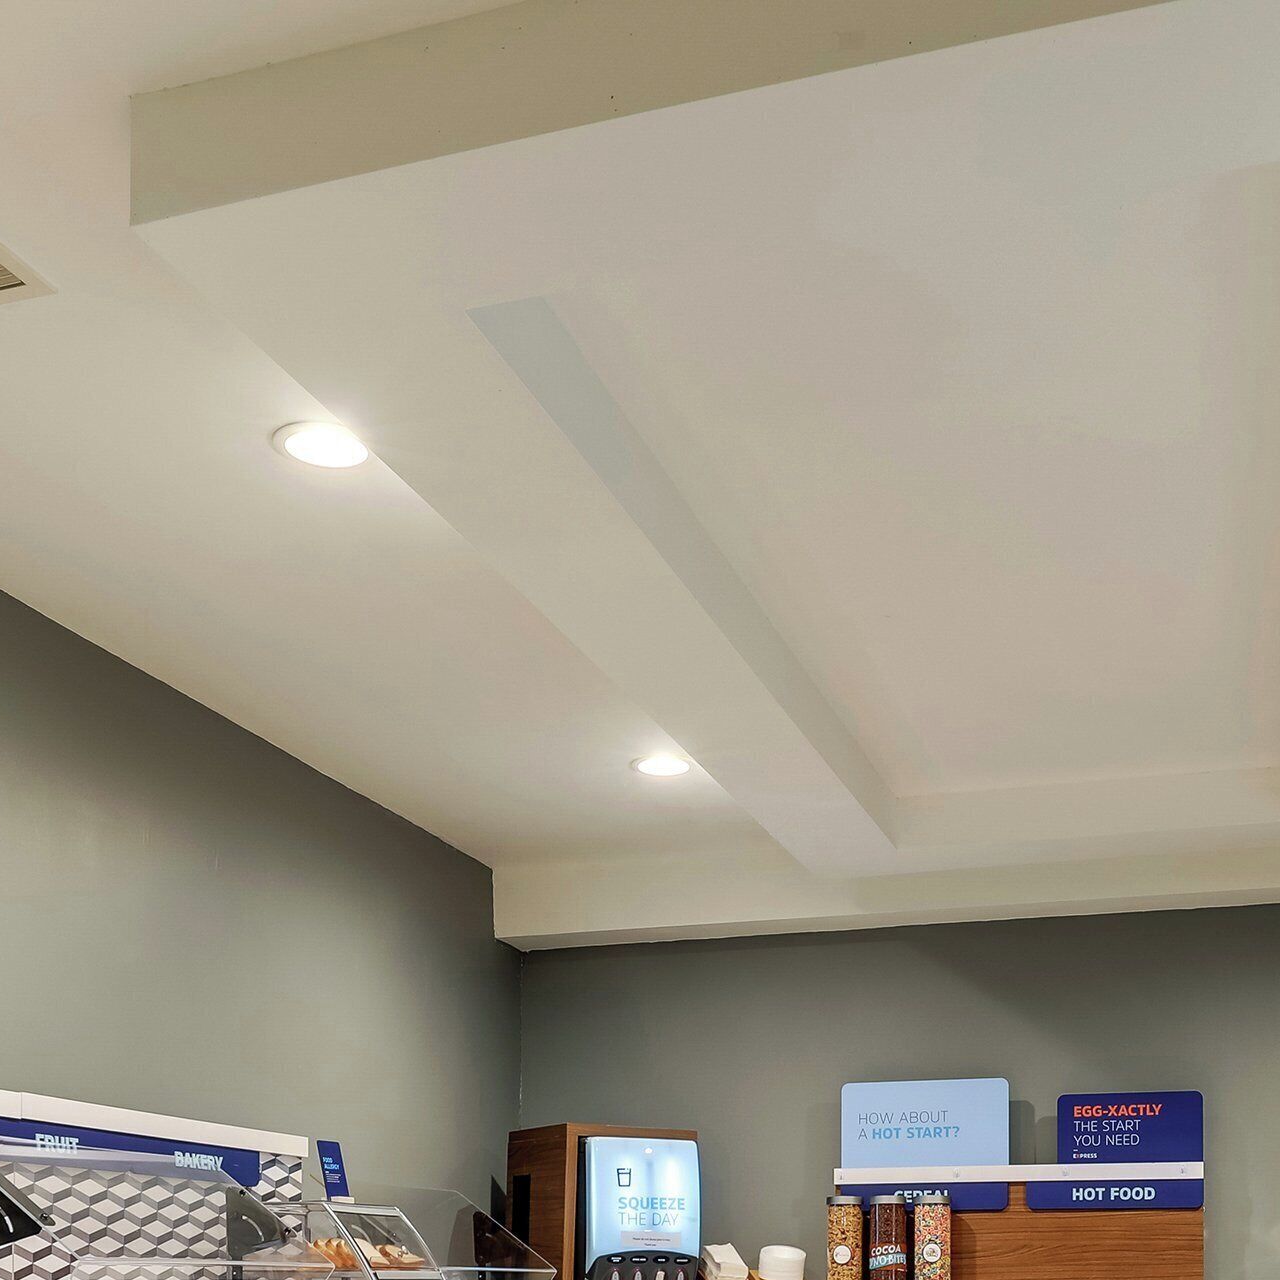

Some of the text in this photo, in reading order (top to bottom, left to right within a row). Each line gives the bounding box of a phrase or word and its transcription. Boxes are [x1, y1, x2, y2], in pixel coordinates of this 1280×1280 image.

[1073, 1104, 1162, 1117] EGG-XACTLY
[858, 1110, 948, 1125] HOW ABOUT
[1074, 1120, 1141, 1132] THE START
[858, 1126, 960, 1140] A HOT START?
[35, 1133, 79, 1154] FRUIT
[1074, 1134, 1140, 1146] YOU NEED
[174, 1151, 224, 1171] BAKERY
[1072, 1187, 1155, 1200] HOT FOOD
[618, 1197, 685, 1210] SQUEEZE
[618, 1212, 678, 1226] THE DAY
[871, 1244, 901, 1256] COCOA
